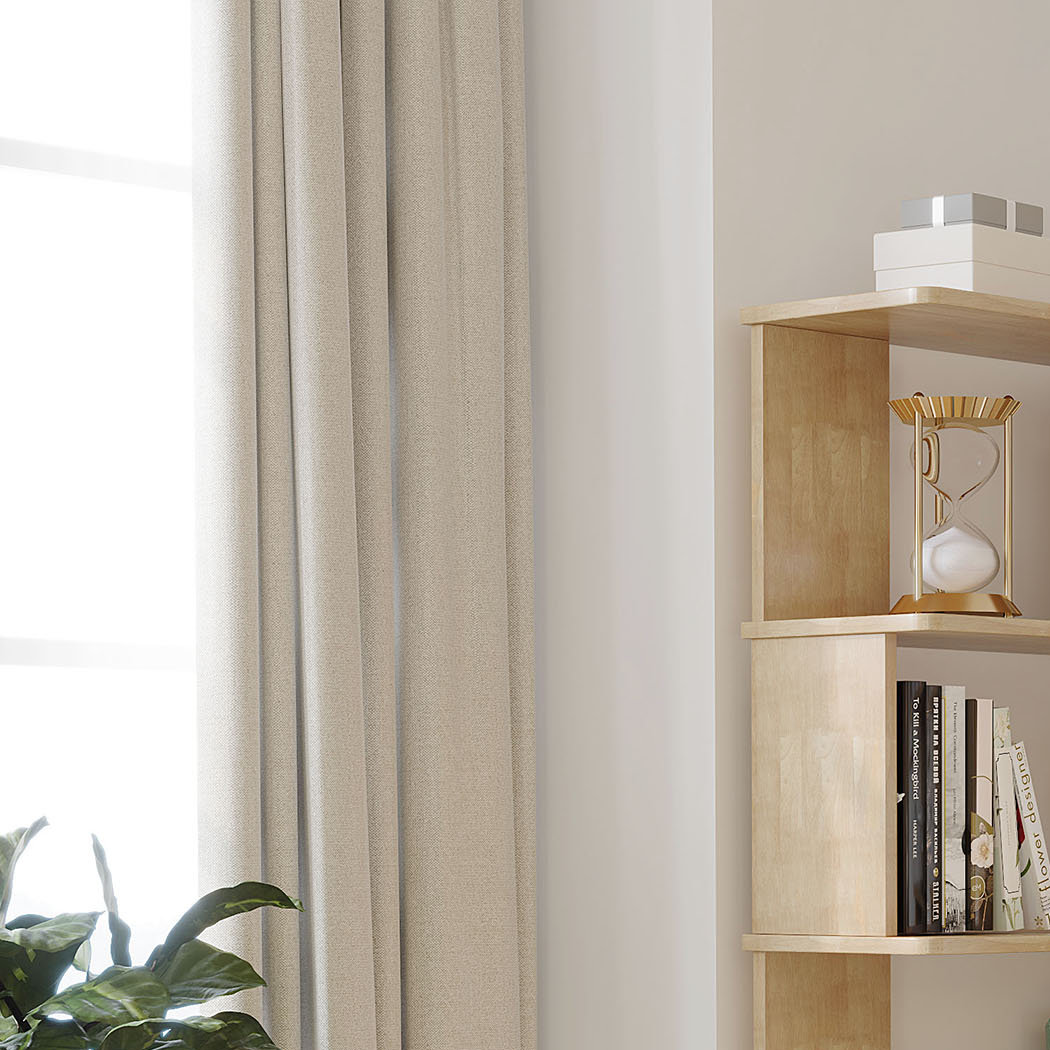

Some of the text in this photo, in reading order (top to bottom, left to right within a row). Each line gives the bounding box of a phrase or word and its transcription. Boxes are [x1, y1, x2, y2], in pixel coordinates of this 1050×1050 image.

[912, 697, 920, 710] To
[912, 712, 920, 727] Kill
[911, 738, 920, 800] Mockingbird
[1014, 743, 1037, 824] designer
[1033, 832, 1050, 893] flower
